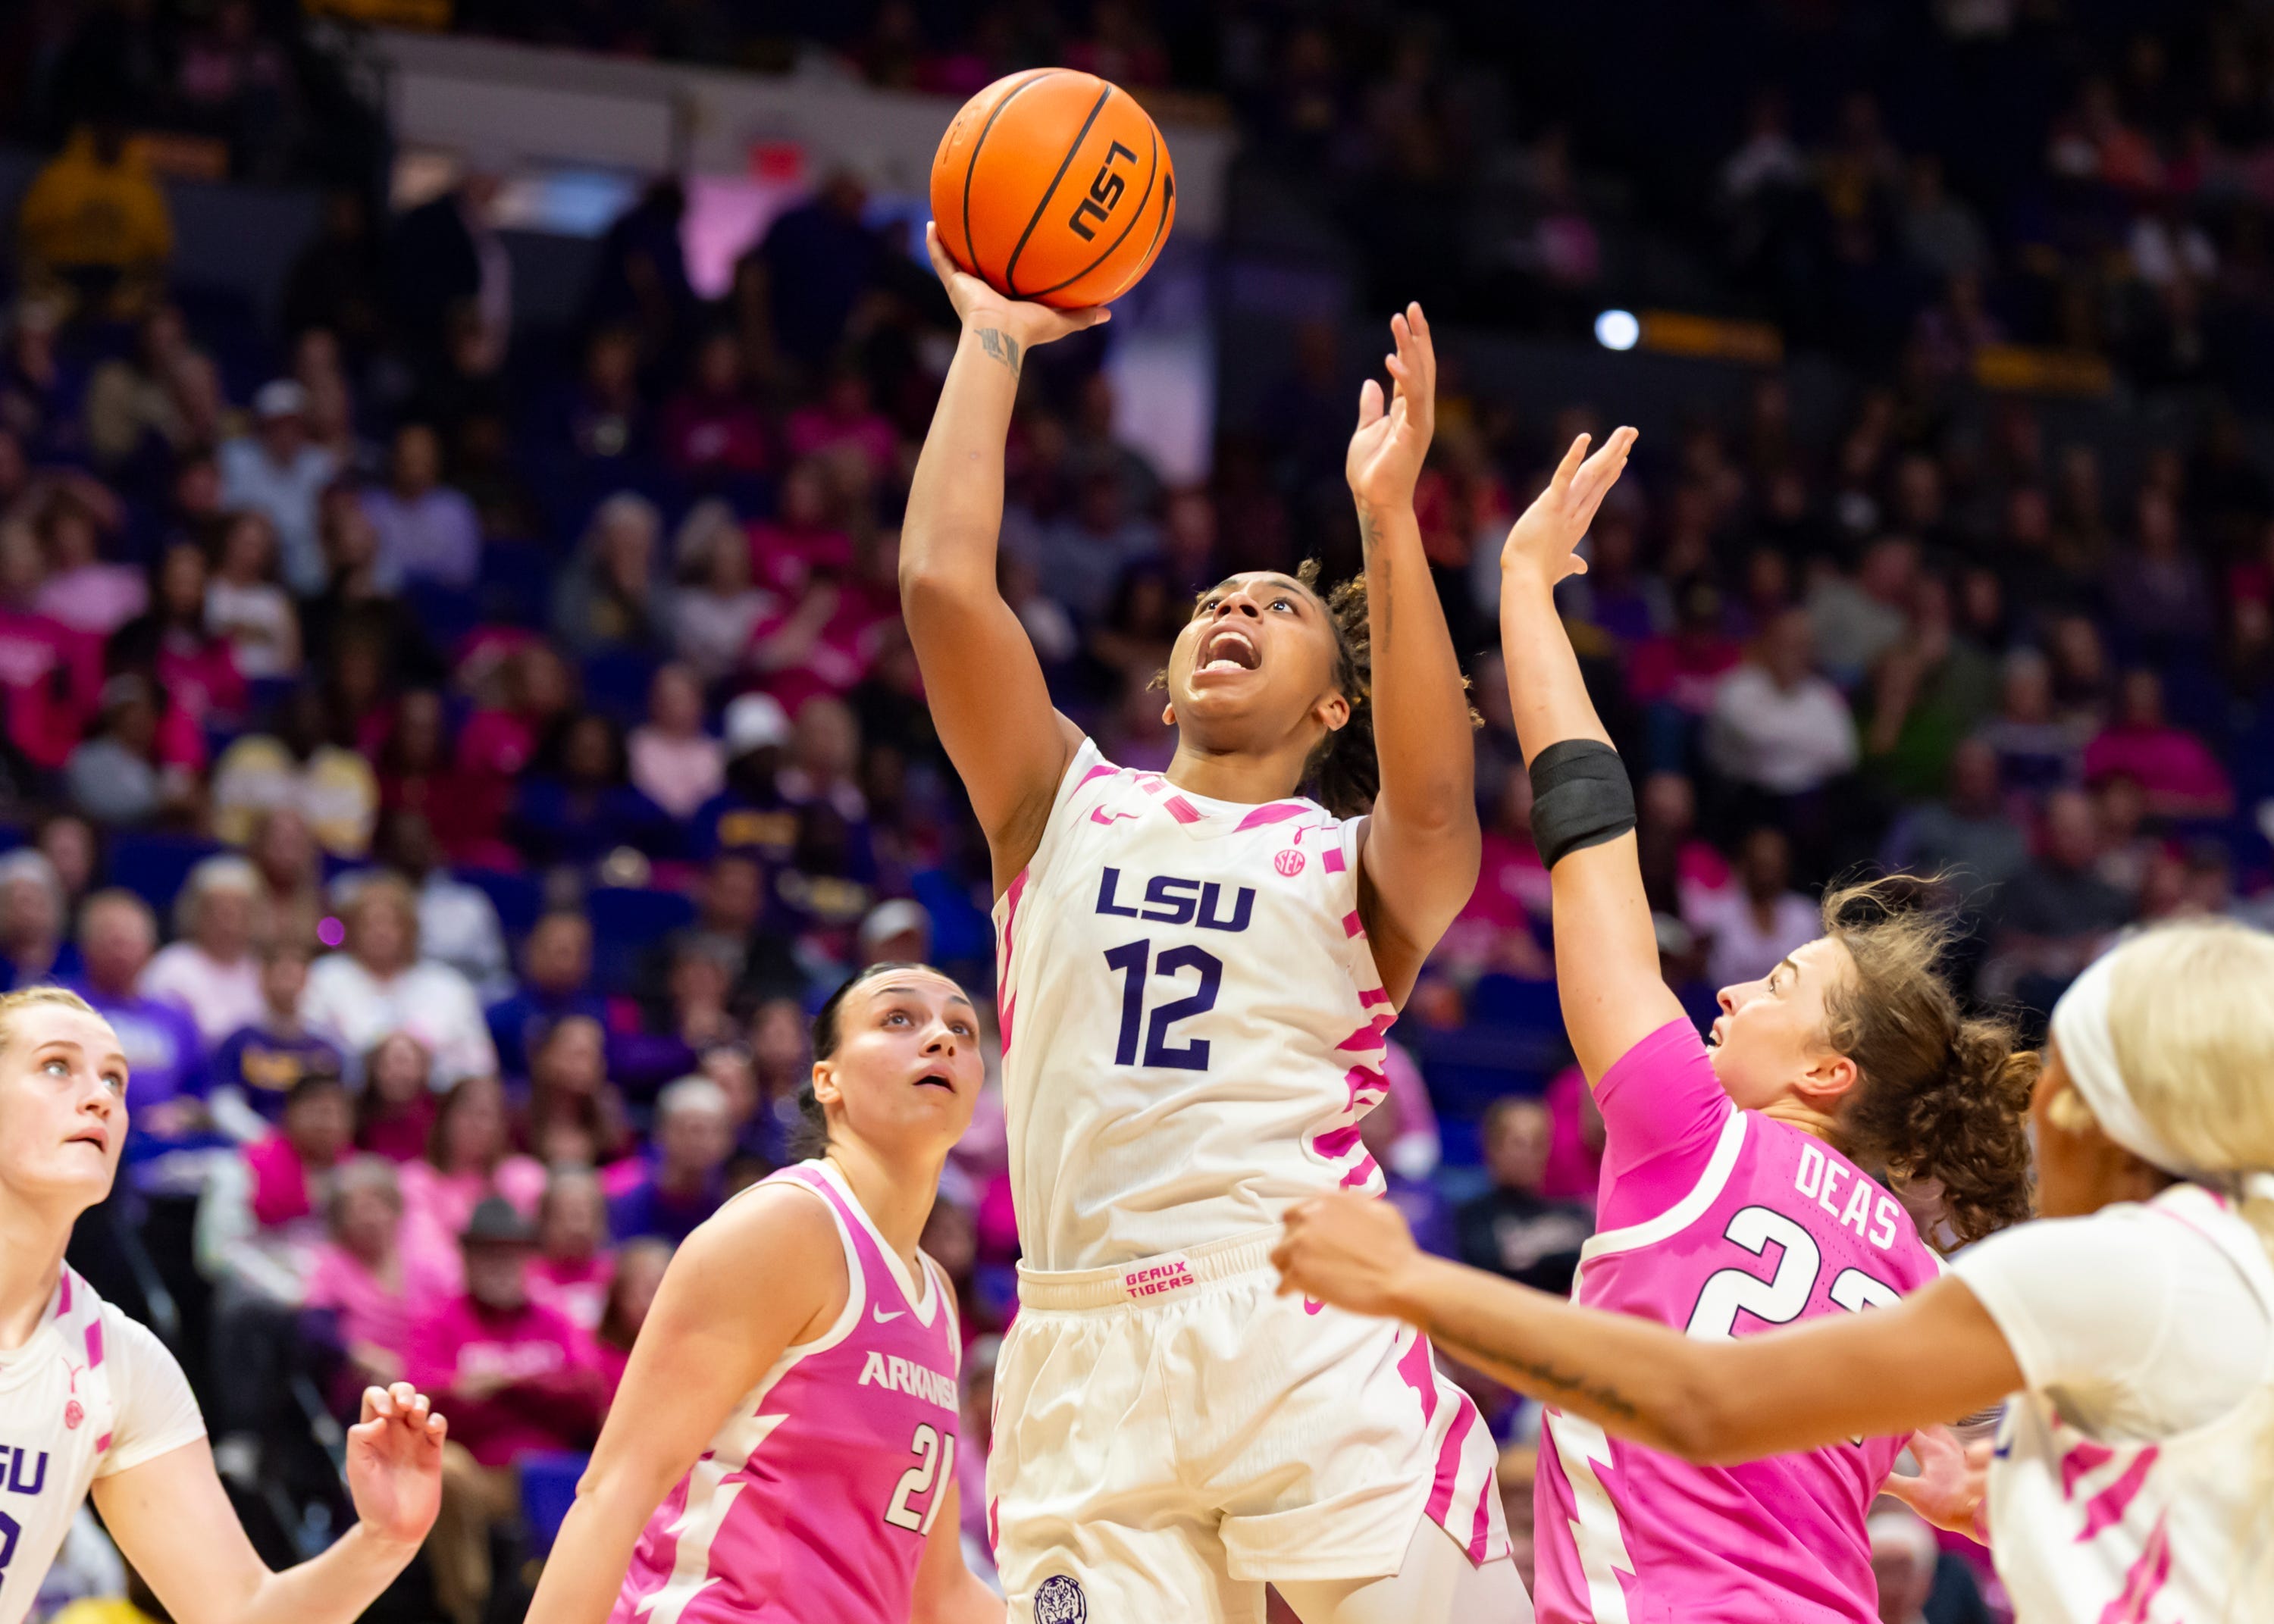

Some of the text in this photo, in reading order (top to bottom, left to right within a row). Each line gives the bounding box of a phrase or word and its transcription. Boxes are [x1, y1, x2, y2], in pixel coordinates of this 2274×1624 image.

[1069, 139, 1138, 243] LSU
[1095, 866, 1256, 933] LSU
[1274, 850, 1305, 877] SEC
[1104, 938, 1223, 1072] 12
[1794, 1142, 1900, 1250] DEAS
[1126, 1261, 1187, 1286] GEAUX
[1127, 1274, 1195, 1298] TIGERS
[884, 1422, 955, 1537] 21
